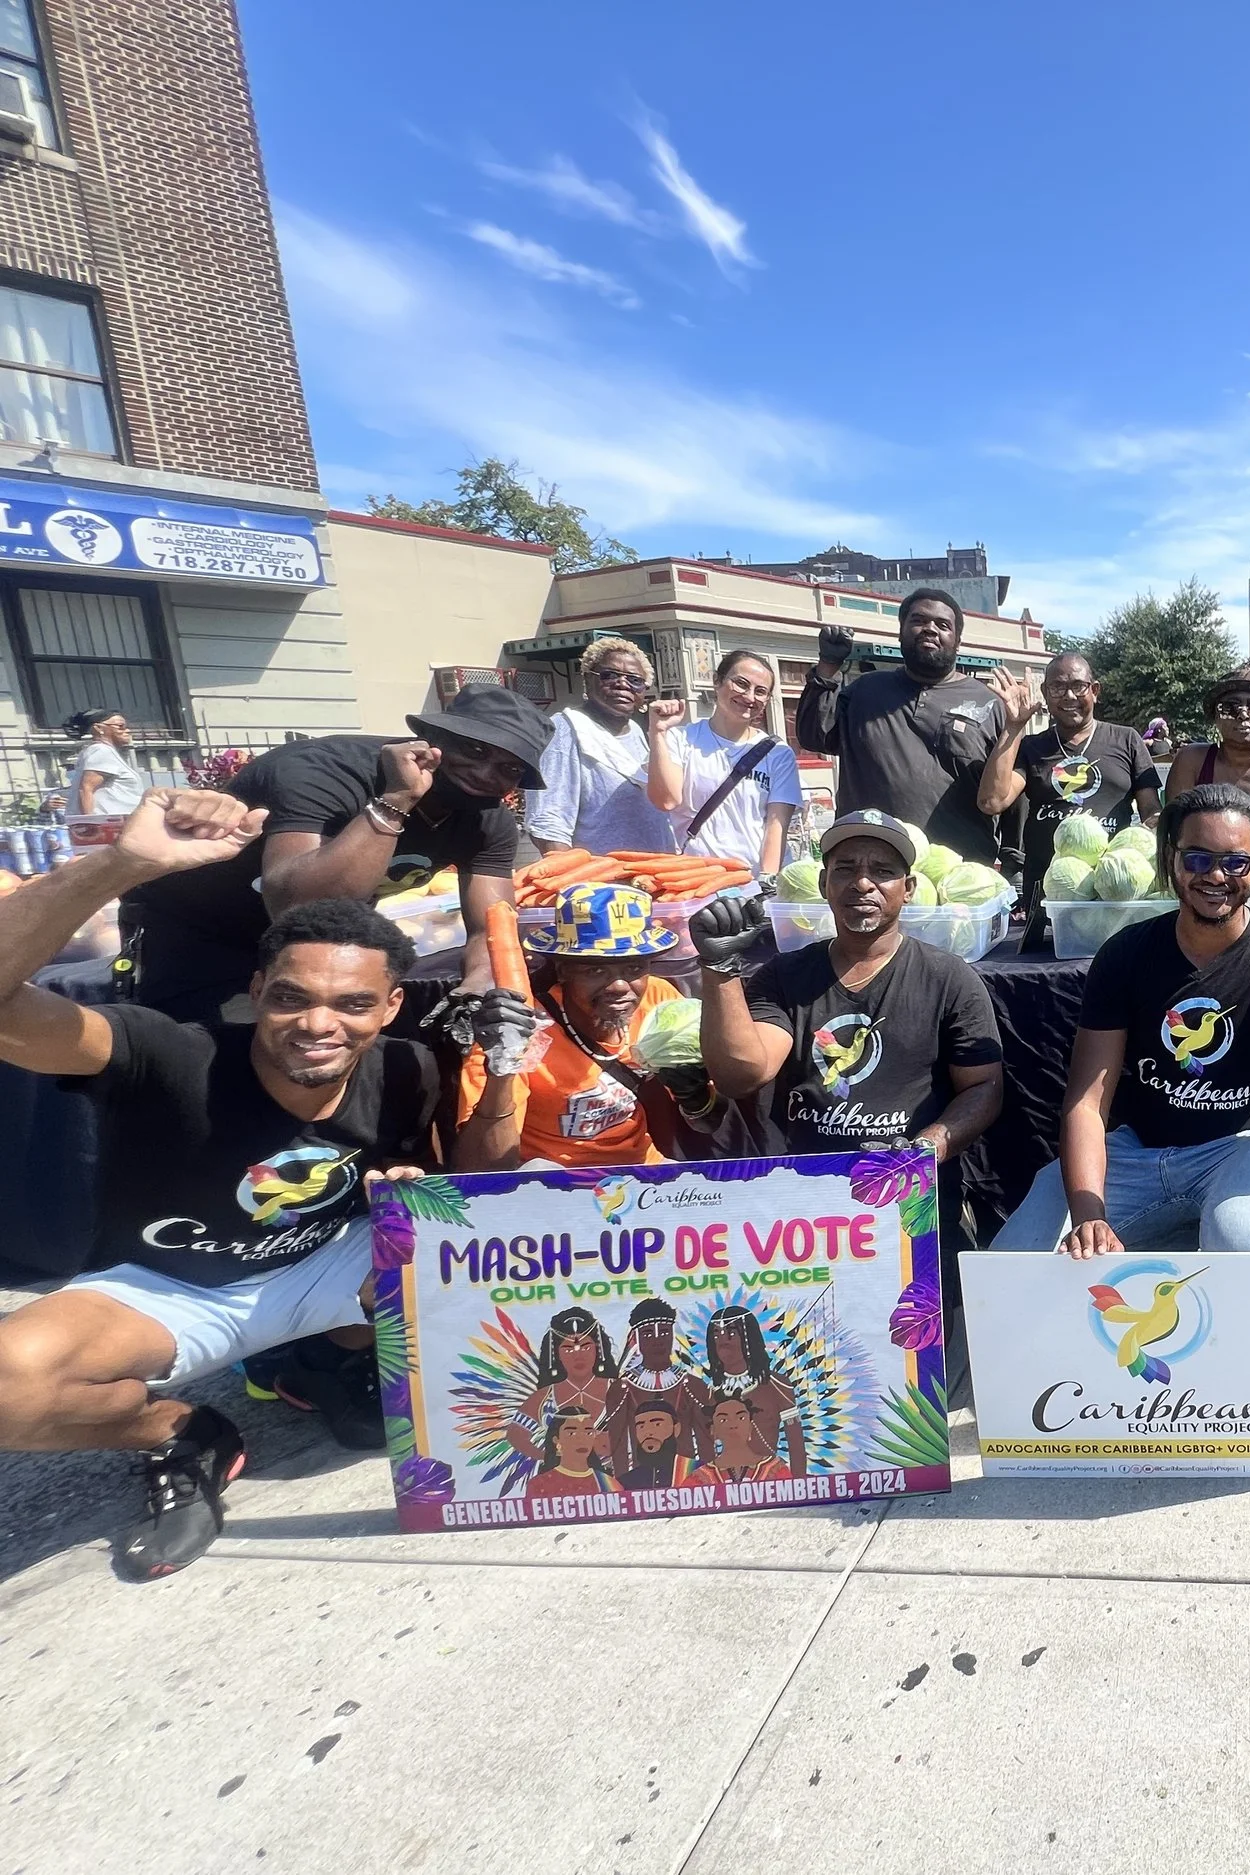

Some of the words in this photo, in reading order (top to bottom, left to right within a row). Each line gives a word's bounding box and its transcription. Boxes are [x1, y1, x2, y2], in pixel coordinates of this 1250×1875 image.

[157, 522, 230, 537] INTERNAL
[231, 532, 296, 545] MEDICINE
[184, 533, 274, 549] CARDIOLOGY
[152, 536, 304, 560] GASTROENTEROLOGY
[174, 547, 289, 566] OPTHALMOLOGY
[153, 553, 307, 579] 718.287.1750
[787, 1090, 910, 1127] Caribbean
[1168, 1096, 1212, 1110] EQUALITY
[1213, 1098, 1250, 1110] PROJECT
[817, 1125, 863, 1136] EQUALITY
[865, 1125, 908, 1136] PROJECT
[637, 1186, 723, 1209] Caribbean
[439, 1227, 665, 1284] MASH-UP
[675, 1223, 729, 1271] DE
[743, 1214, 877, 1265] VOTE
[489, 1285, 557, 1303] OUR
[664, 1273, 729, 1293] OUR
[741, 1266, 834, 1287] VOICE
[1127, 1421, 1199, 1436] EQUALITY
[986, 1443, 1072, 1454] ADVOCATING
[1075, 1443, 1099, 1454] FOR
[1102, 1443, 1173, 1454] CARIBBEAN
[1176, 1443, 1224, 1454] LGBTQ+
[442, 1500, 528, 1526] GENERAL
[533, 1493, 628, 1521] ELECTION:
[631, 1485, 720, 1514] TUESDAY,
[725, 1478, 830, 1506] NOVEMBER
[835, 1474, 854, 1499] 5,
[858, 1471, 908, 1496] 2024
